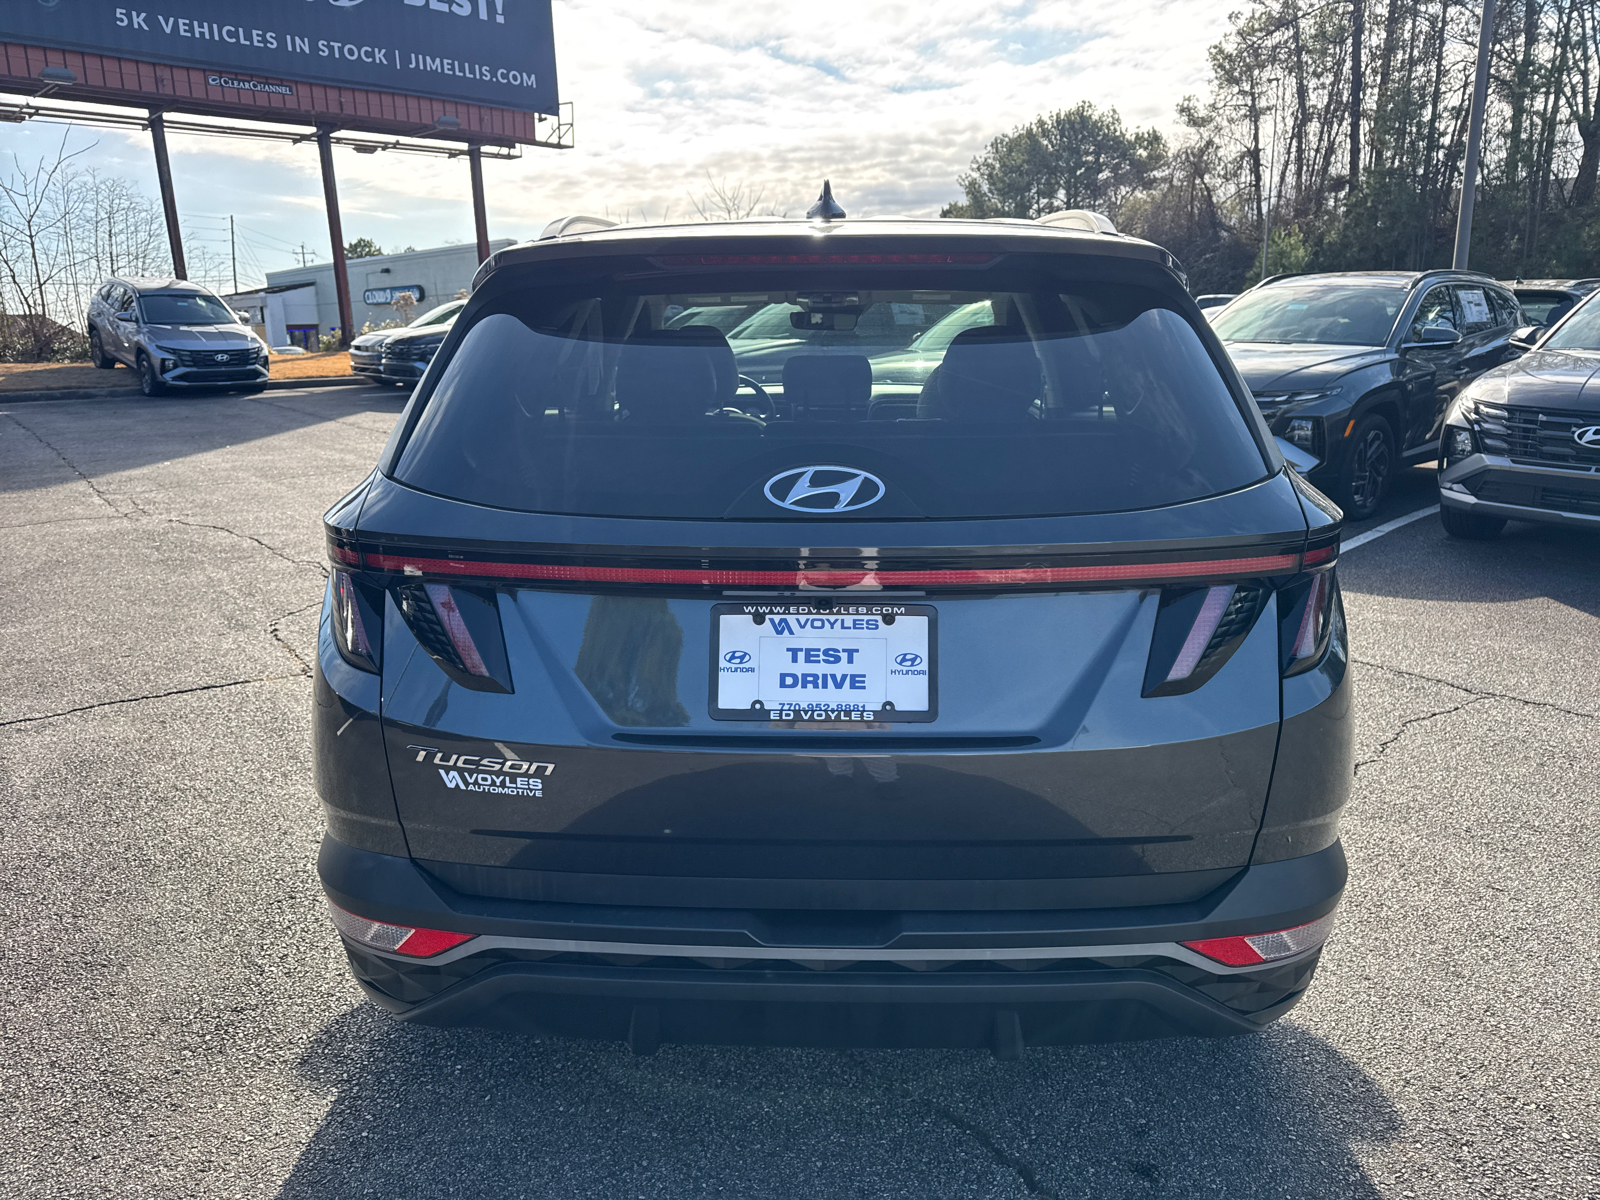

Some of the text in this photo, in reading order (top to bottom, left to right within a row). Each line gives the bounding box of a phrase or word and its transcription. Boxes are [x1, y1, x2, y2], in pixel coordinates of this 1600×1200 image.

[115, 8, 149, 31] 5K
[157, 15, 278, 49] VEHICLES
[286, 34, 310, 54] IN
[318, 40, 388, 65] STOCK
[408, 53, 537, 88] JIMELLIS.COM
[795, 618, 880, 631] VOYLES
[786, 647, 860, 664] TEST
[719, 666, 756, 674] HYUNDAI
[890, 669, 927, 677] HYUNDAI
[779, 672, 867, 690] DRIVE
[769, 710, 875, 721] ED VOYLES
[463, 772, 543, 790] VOYLES
[467, 783, 543, 798] AUTOMOTIVE
